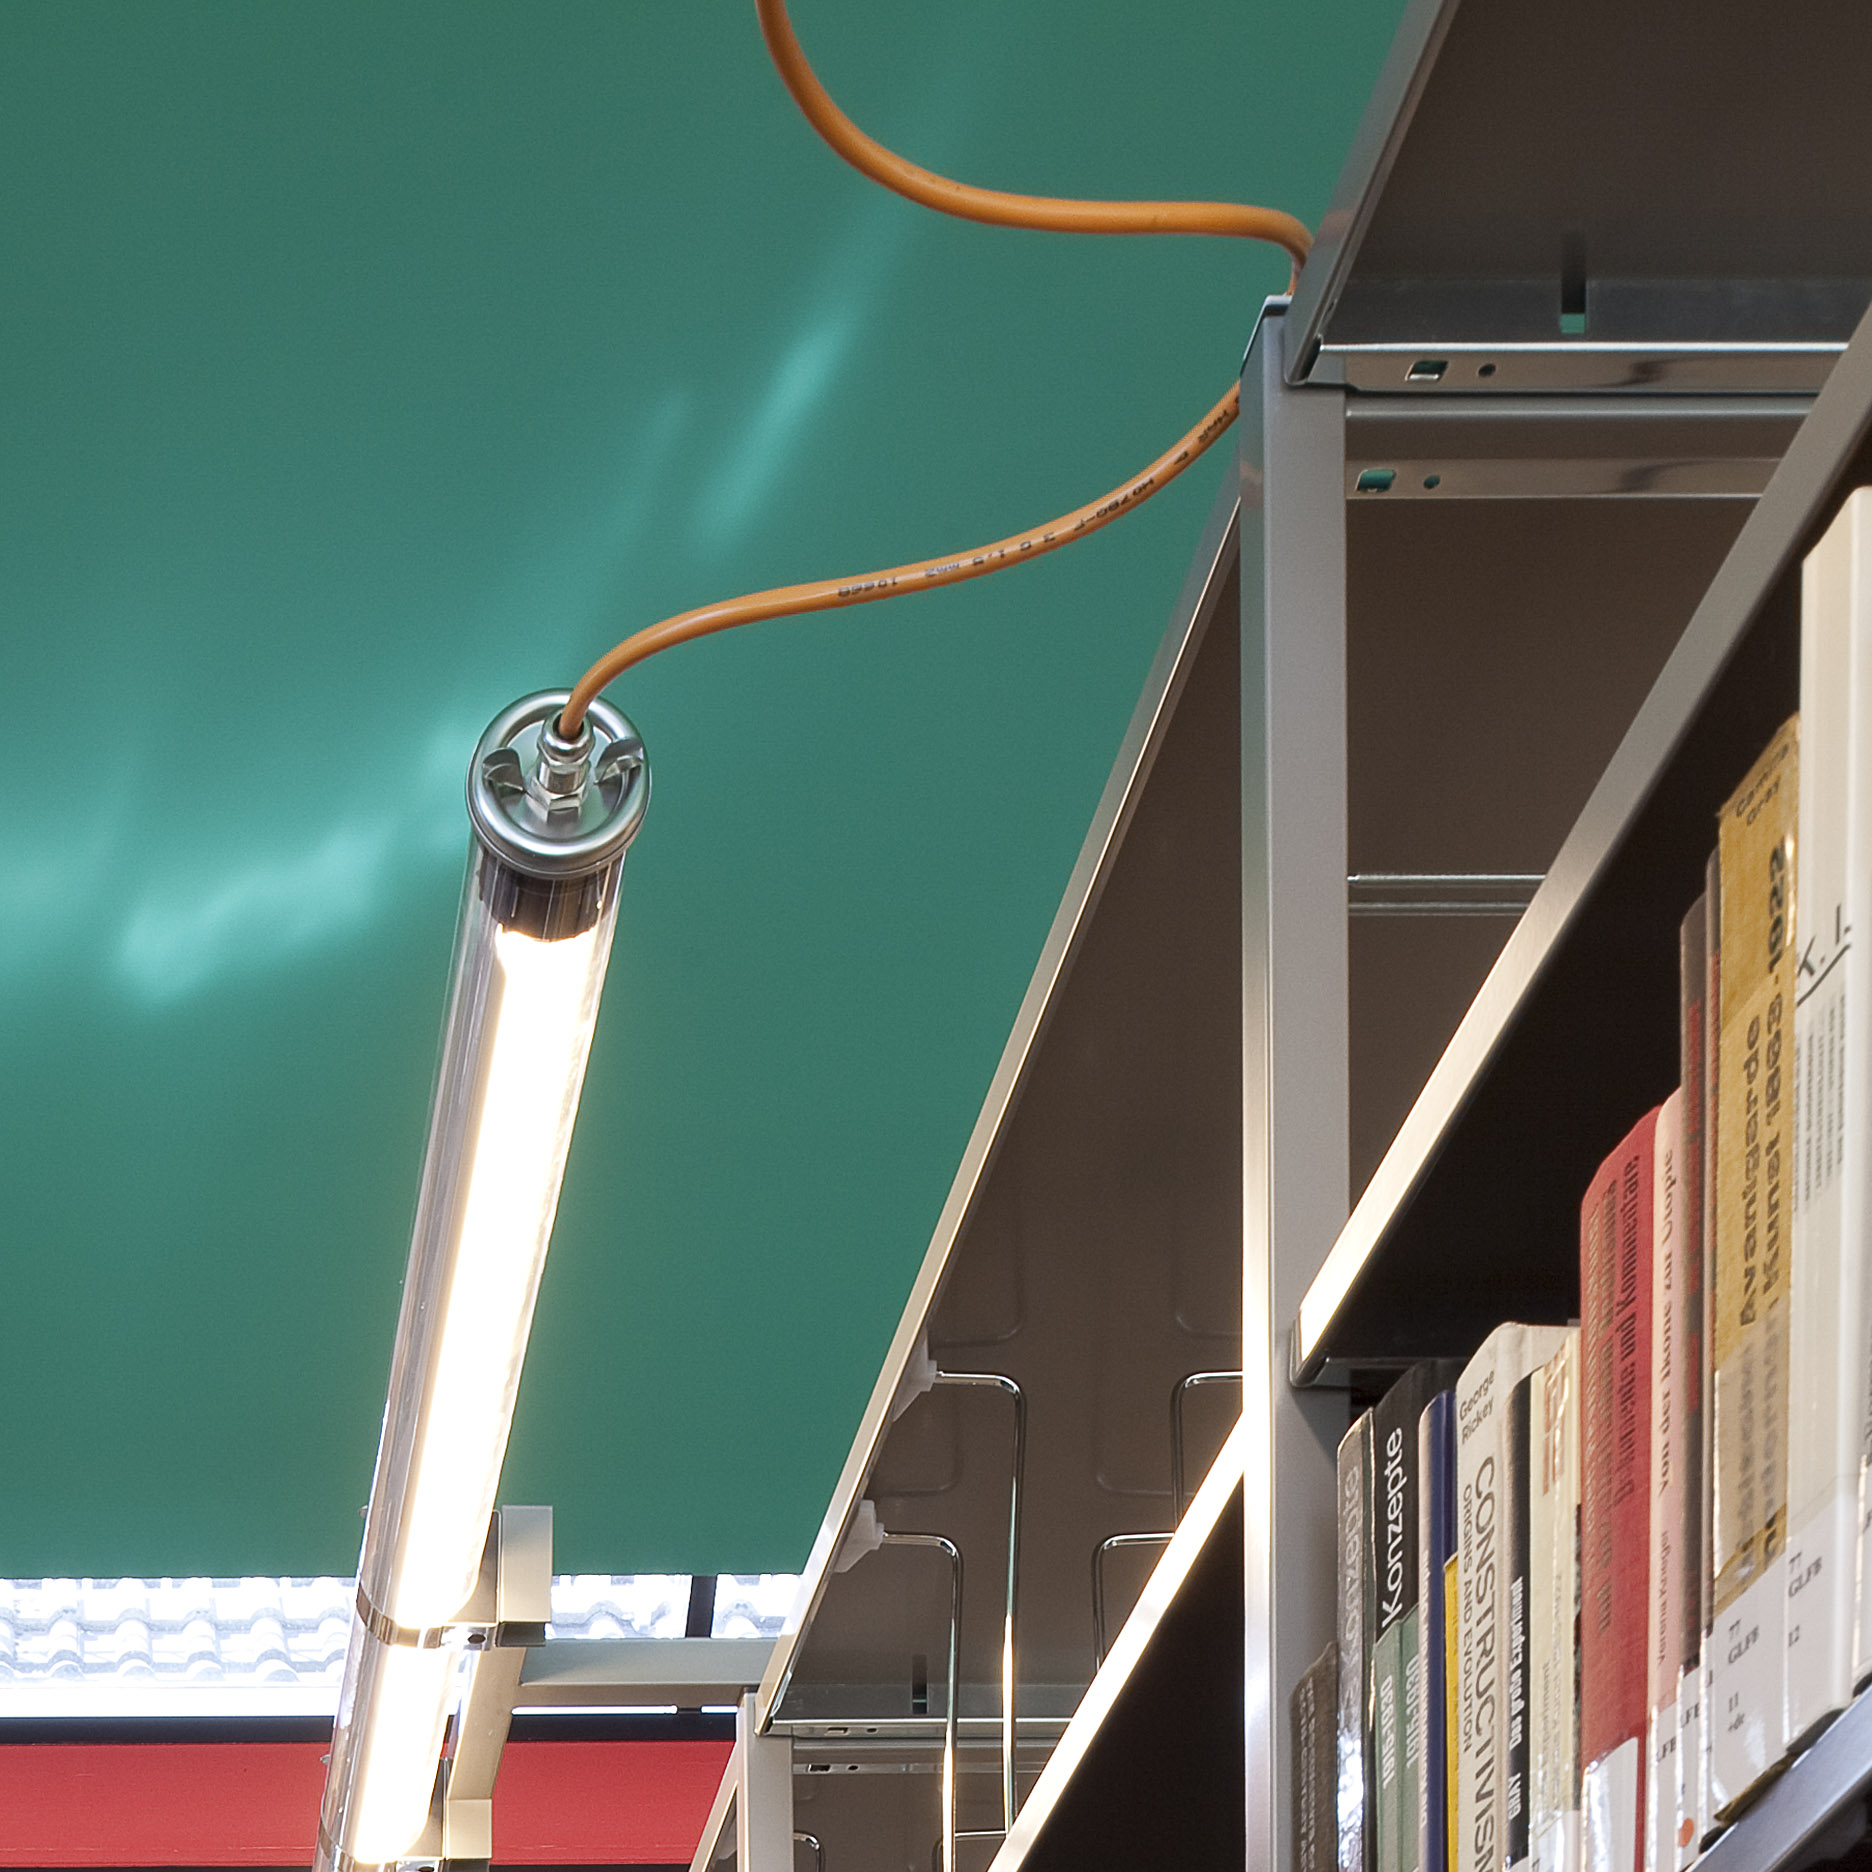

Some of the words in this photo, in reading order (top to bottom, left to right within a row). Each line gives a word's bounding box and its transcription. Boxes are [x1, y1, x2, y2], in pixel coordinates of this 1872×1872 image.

[1660, 1149, 1677, 1236] Utopie
[1660, 1240, 1674, 1290] zur
[1614, 1312, 1638, 1357] und
[1659, 1302, 1674, 1383] Ikone
[1458, 1368, 1496, 1421] George
[1381, 1427, 1408, 1627] Konzepte
[1461, 1484, 1473, 1576] ORIGINS
[1461, 1581, 1473, 1626] AND
[1509, 1576, 1525, 1667] Experiment
[1381, 1674, 1395, 1789] 1915-1930
[1458, 1631, 1474, 1754] EVOLUTION
[1509, 1719, 1523, 1750] Das
[1508, 1772, 1522, 1819] GRAY
